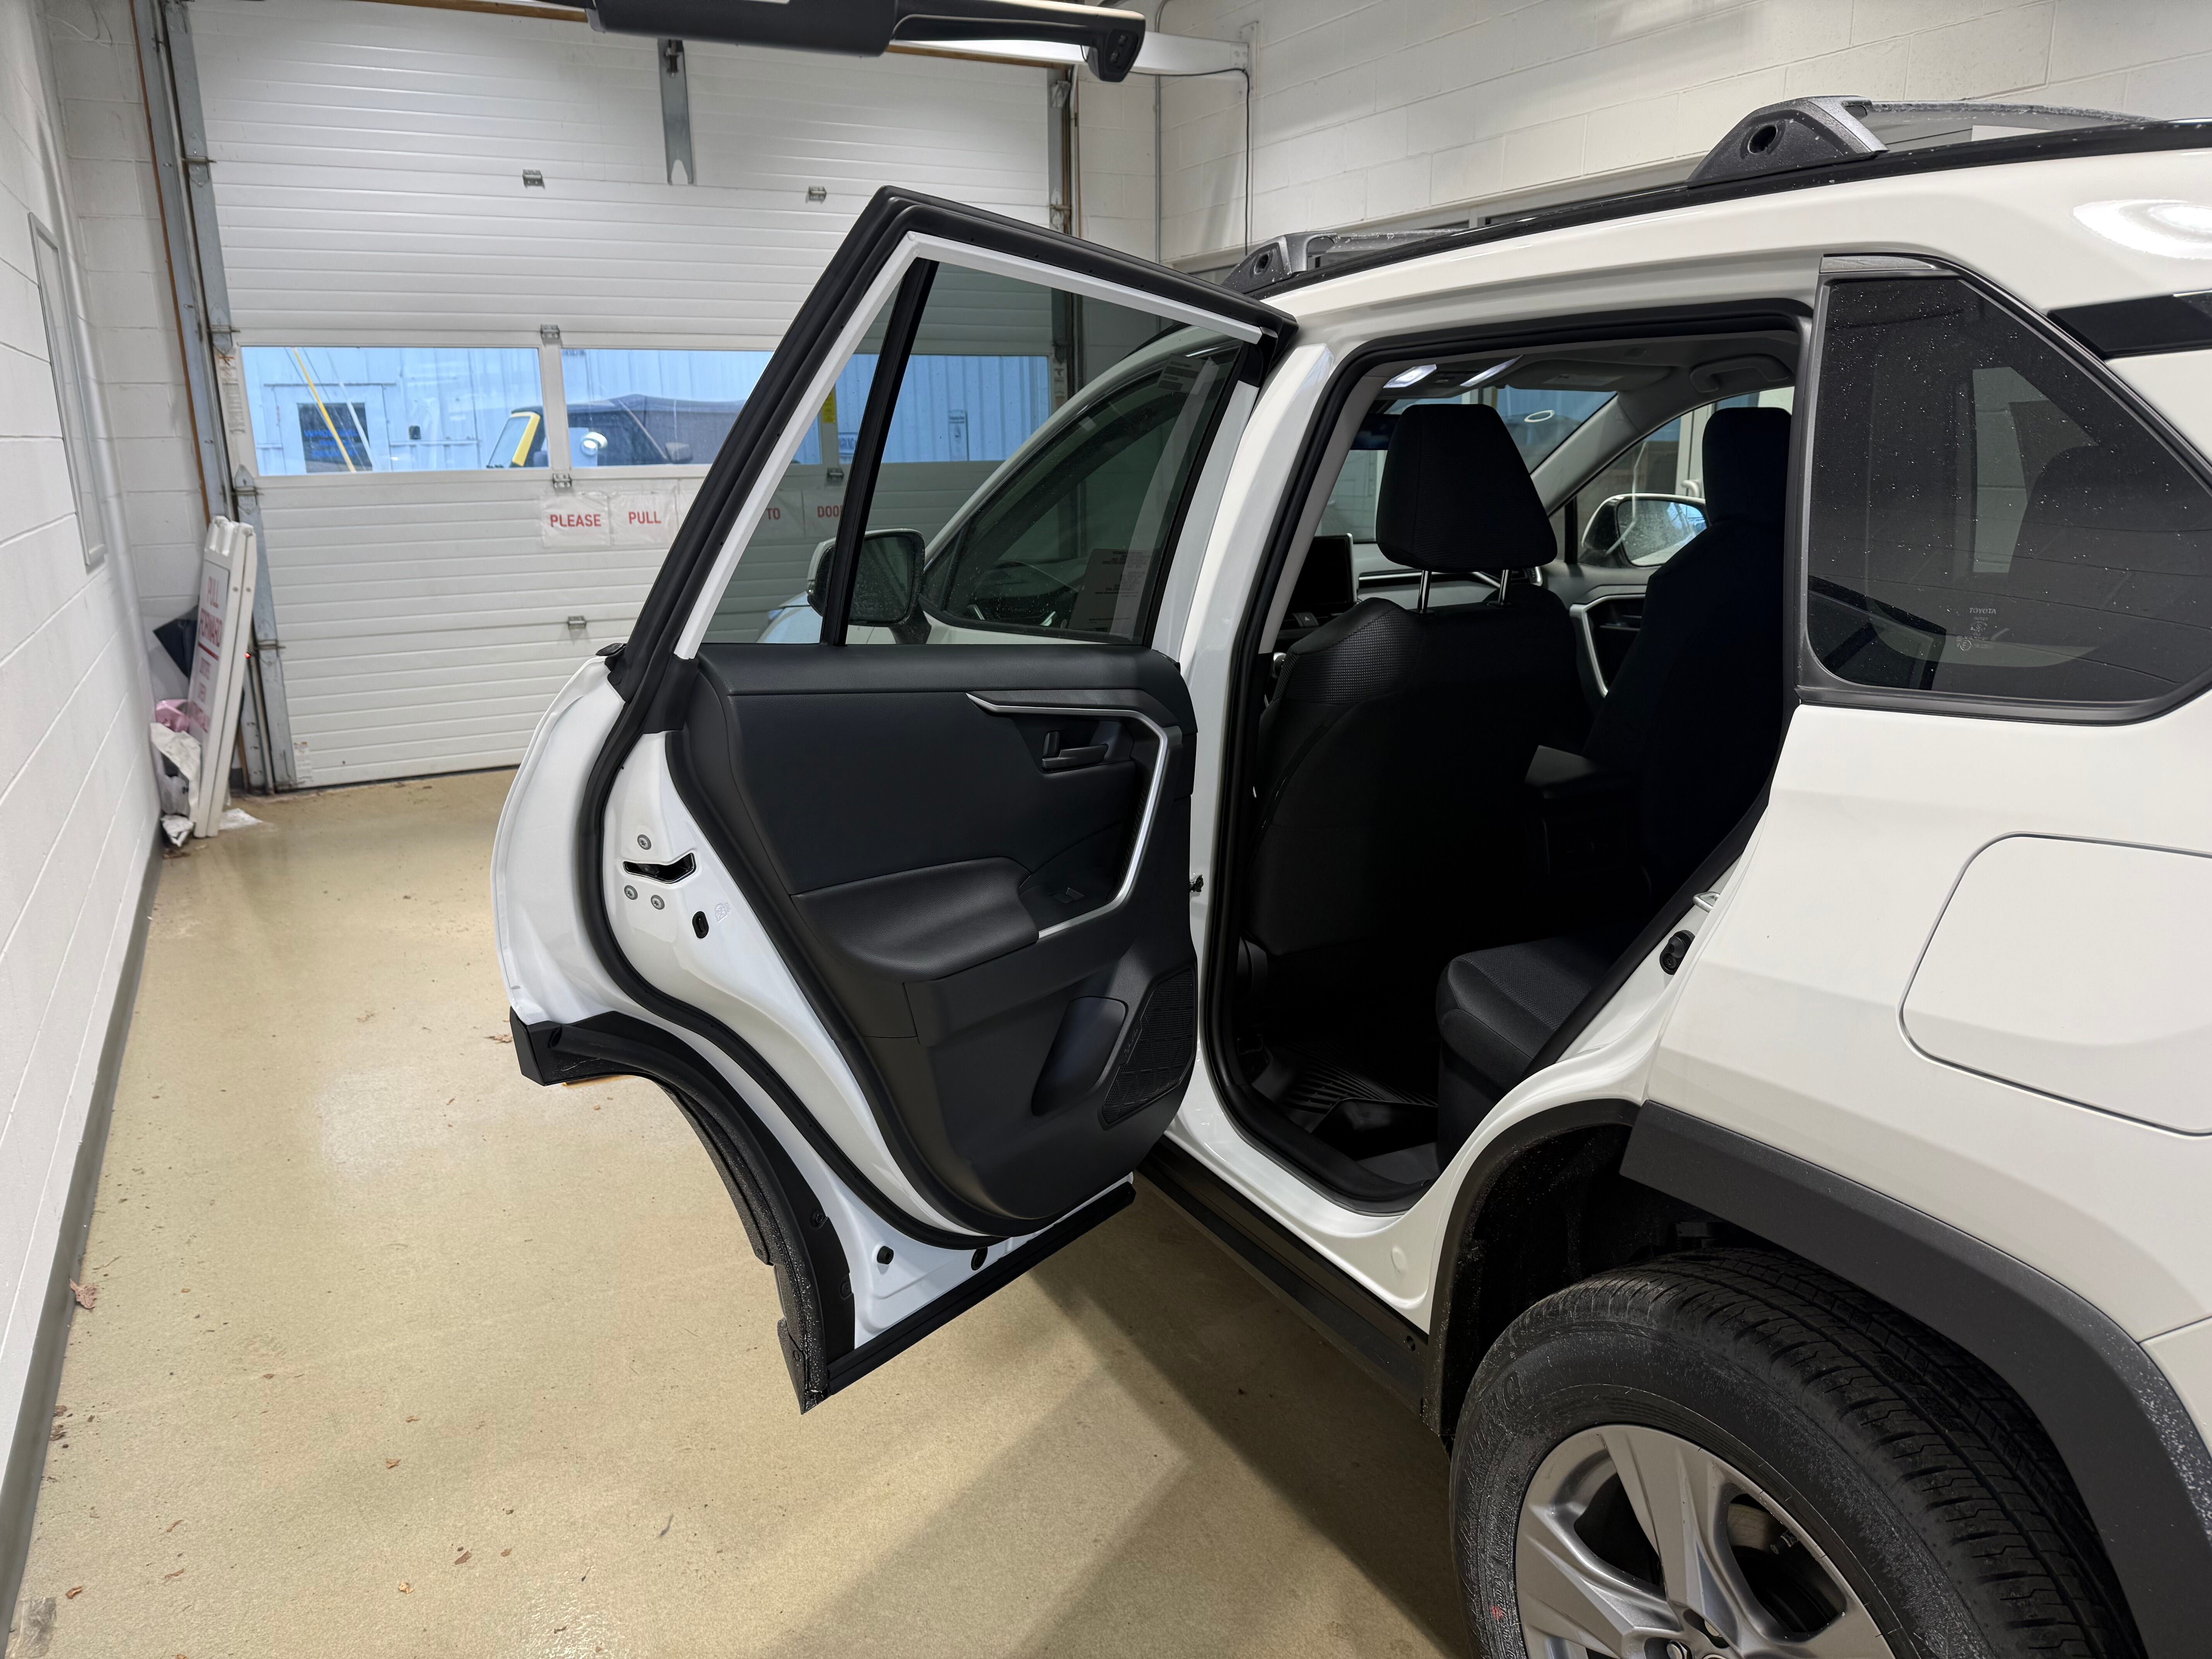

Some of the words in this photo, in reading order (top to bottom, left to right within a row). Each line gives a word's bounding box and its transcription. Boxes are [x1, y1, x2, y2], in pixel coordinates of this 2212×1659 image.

[550, 514, 601, 527] PLEASE
[629, 511, 661, 524] PULL
[766, 508, 780, 520] TO
[817, 505, 843, 518] DOO
